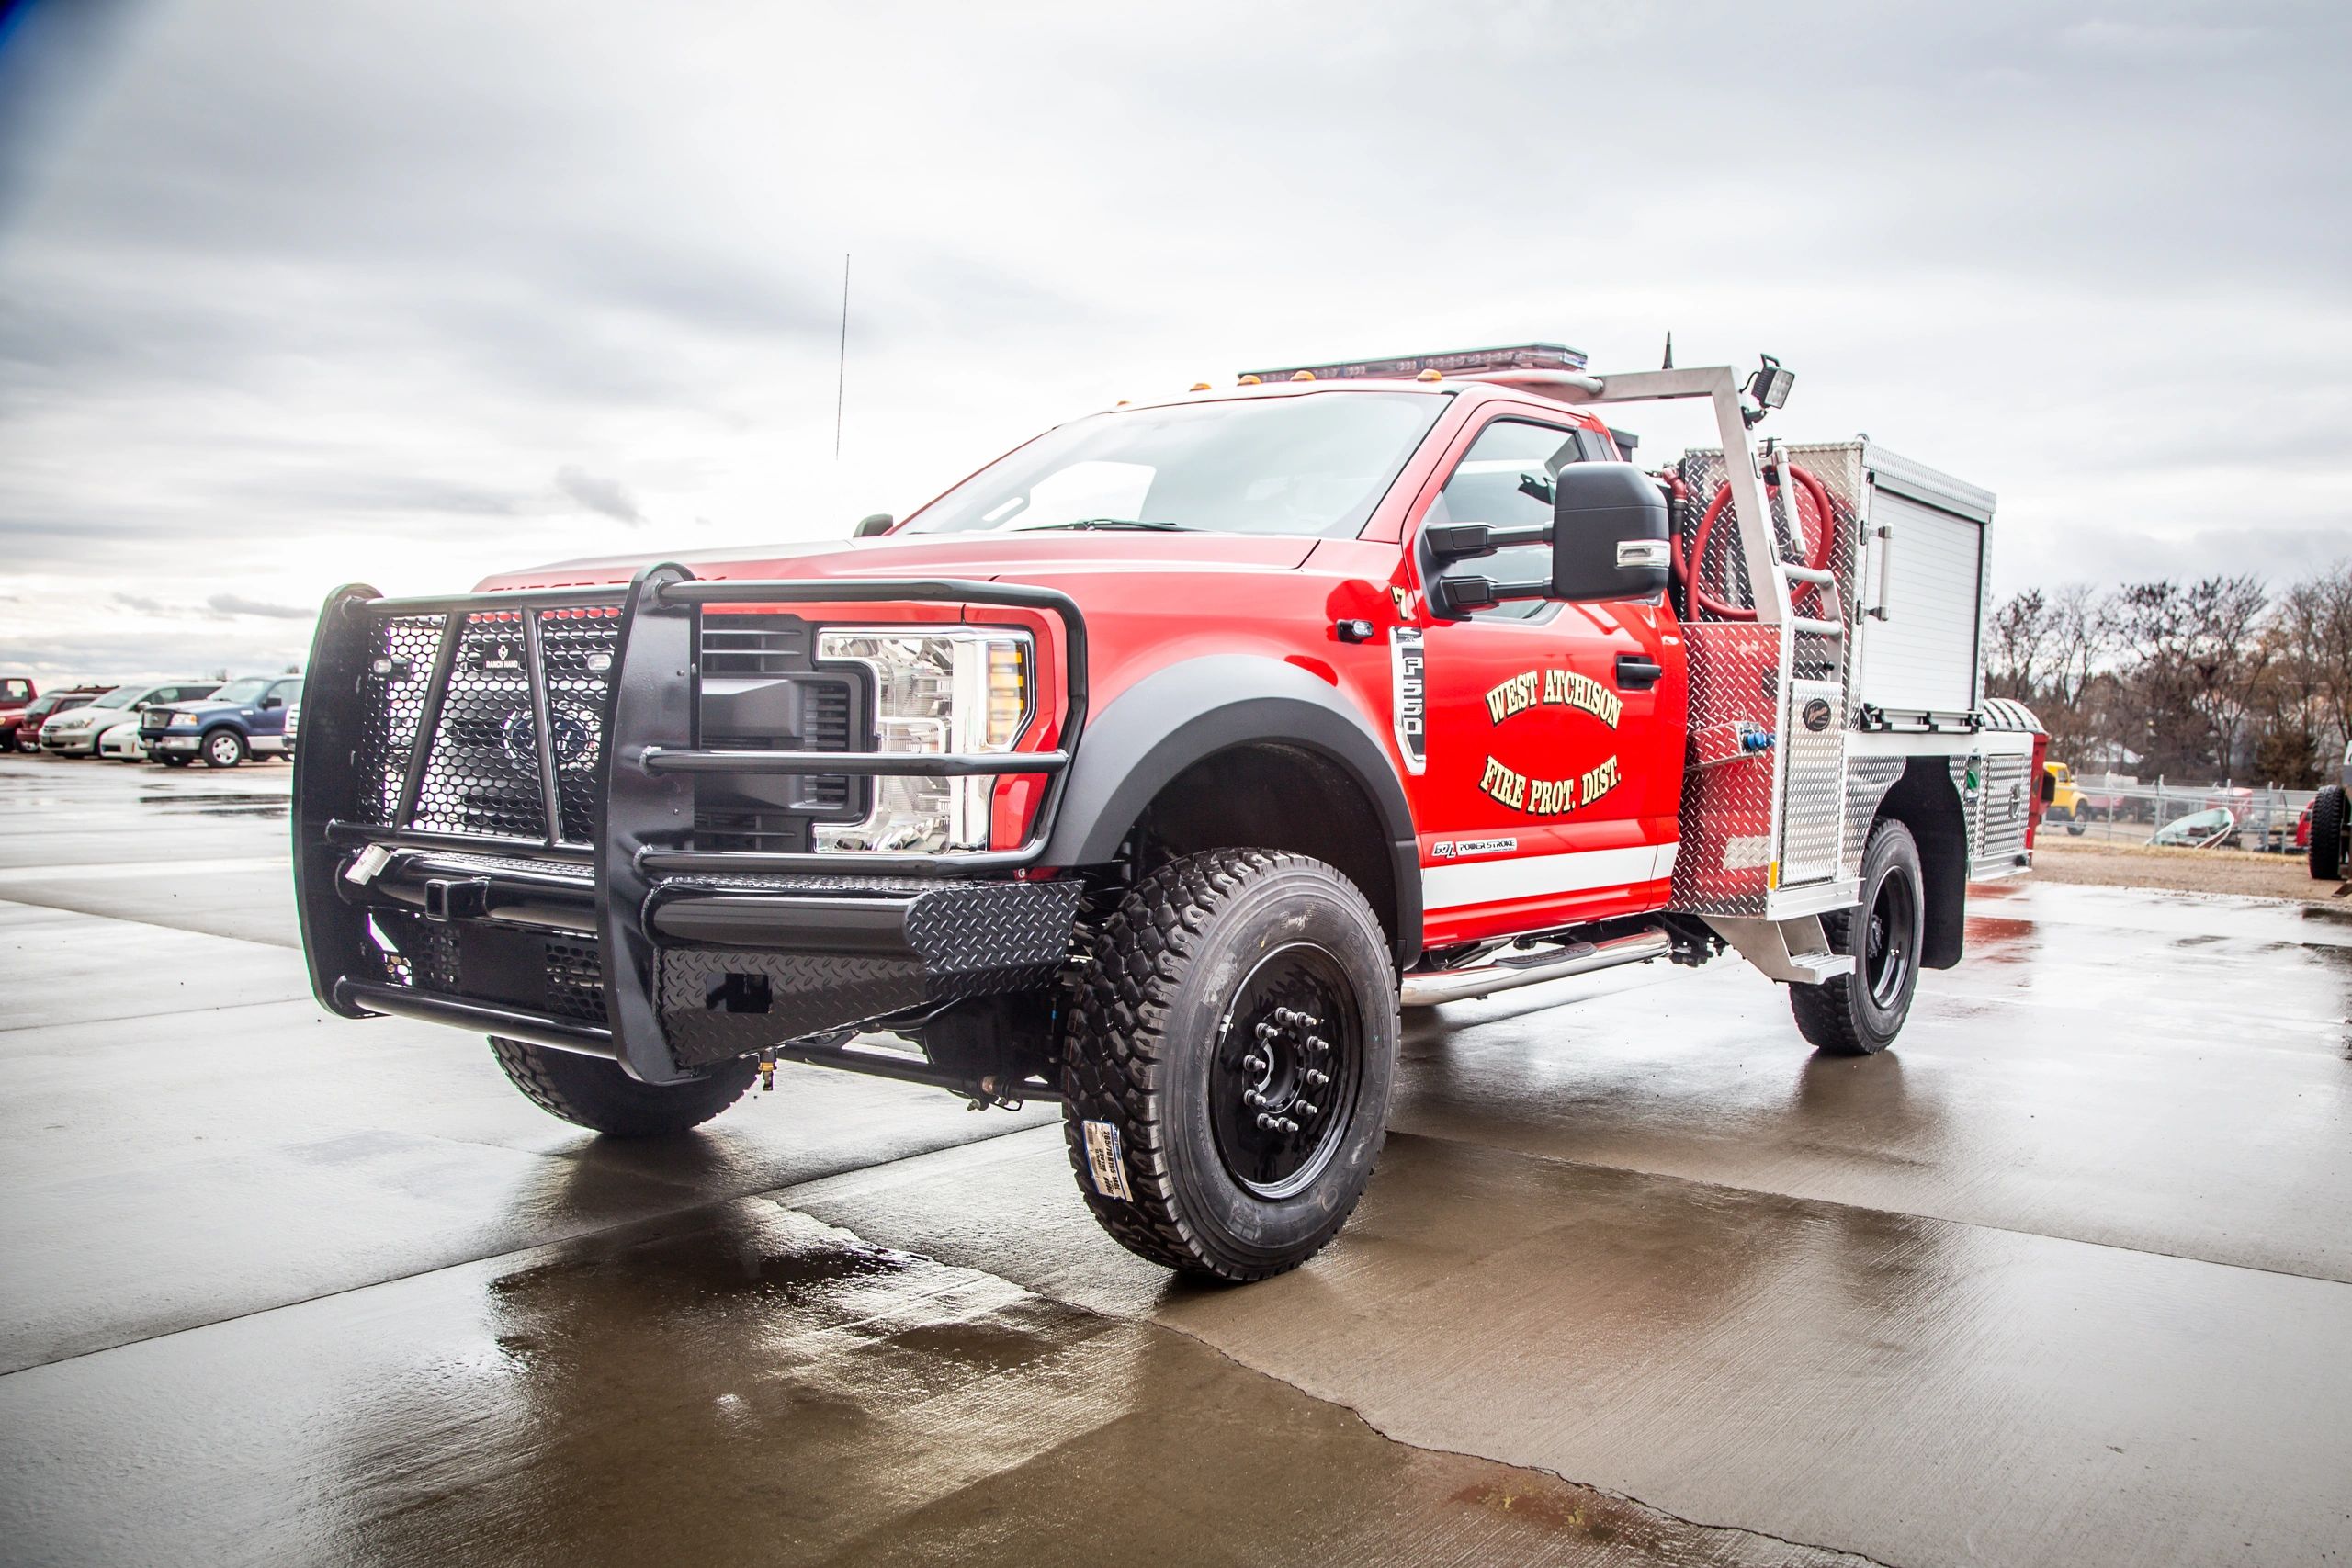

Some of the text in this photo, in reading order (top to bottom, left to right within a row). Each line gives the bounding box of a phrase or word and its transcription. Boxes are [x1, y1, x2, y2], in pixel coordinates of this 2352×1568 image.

[1391, 586, 1408, 620] 7
[1485, 669, 1623, 731] WEST ATCHISON
[1478, 754, 1622, 816] FIRE PROT. DIST.
[1460, 842, 1485, 851] POWER
[1487, 840, 1515, 849] STROKE
